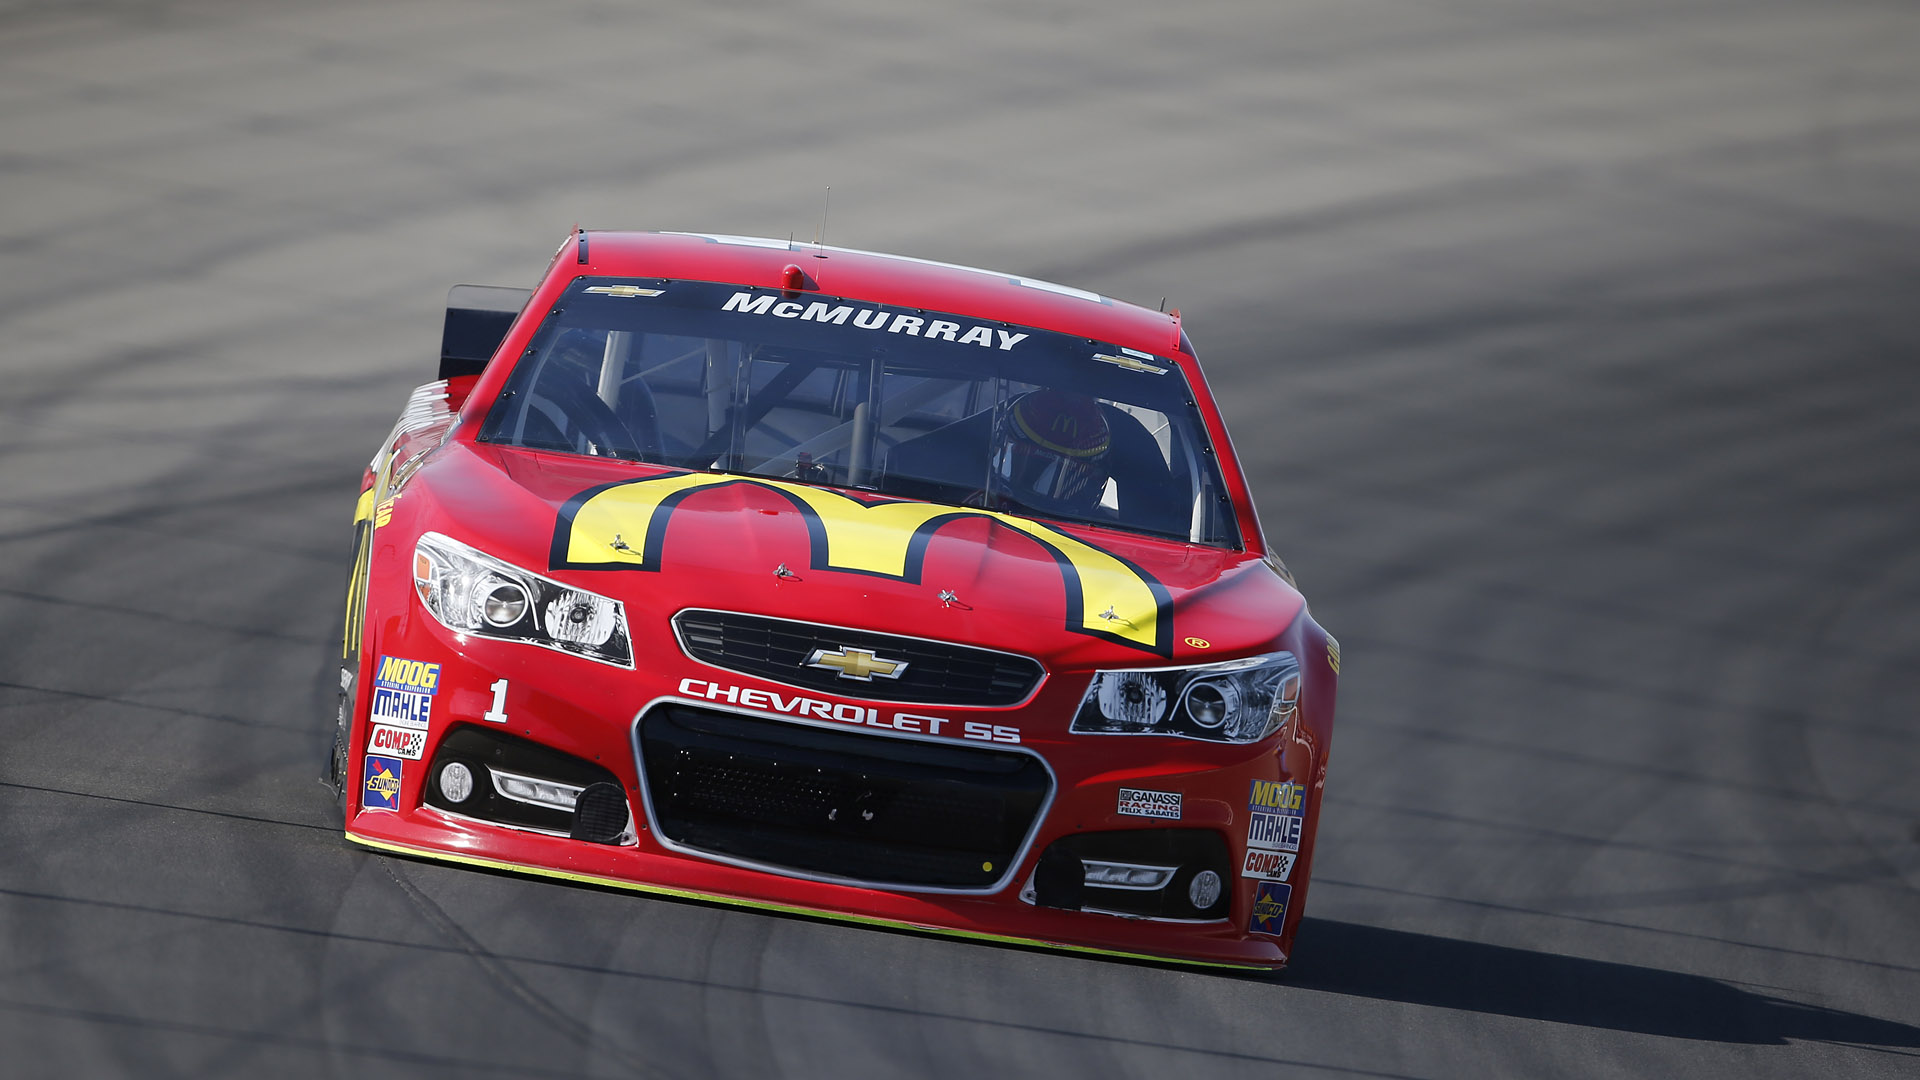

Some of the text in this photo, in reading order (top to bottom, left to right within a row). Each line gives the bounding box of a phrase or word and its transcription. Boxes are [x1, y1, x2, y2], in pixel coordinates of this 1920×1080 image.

[721, 292, 1029, 350] McMURRAY
[377, 656, 440, 688] MOOG
[374, 689, 430, 723] MAHLE
[483, 678, 509, 723] 1
[678, 677, 1021, 743] CHEVROLET SS
[374, 728, 411, 749] COMP
[397, 747, 417, 757] CAMS
[369, 776, 399, 792] SUNOCO
[1250, 780, 1304, 810] MOOG
[1120, 800, 1180, 812] RACING
[1131, 791, 1180, 806] GANASSI
[1121, 807, 1180, 818] FELIX SABATES
[1249, 813, 1301, 845] MAHLE
[1246, 852, 1279, 873] COMP
